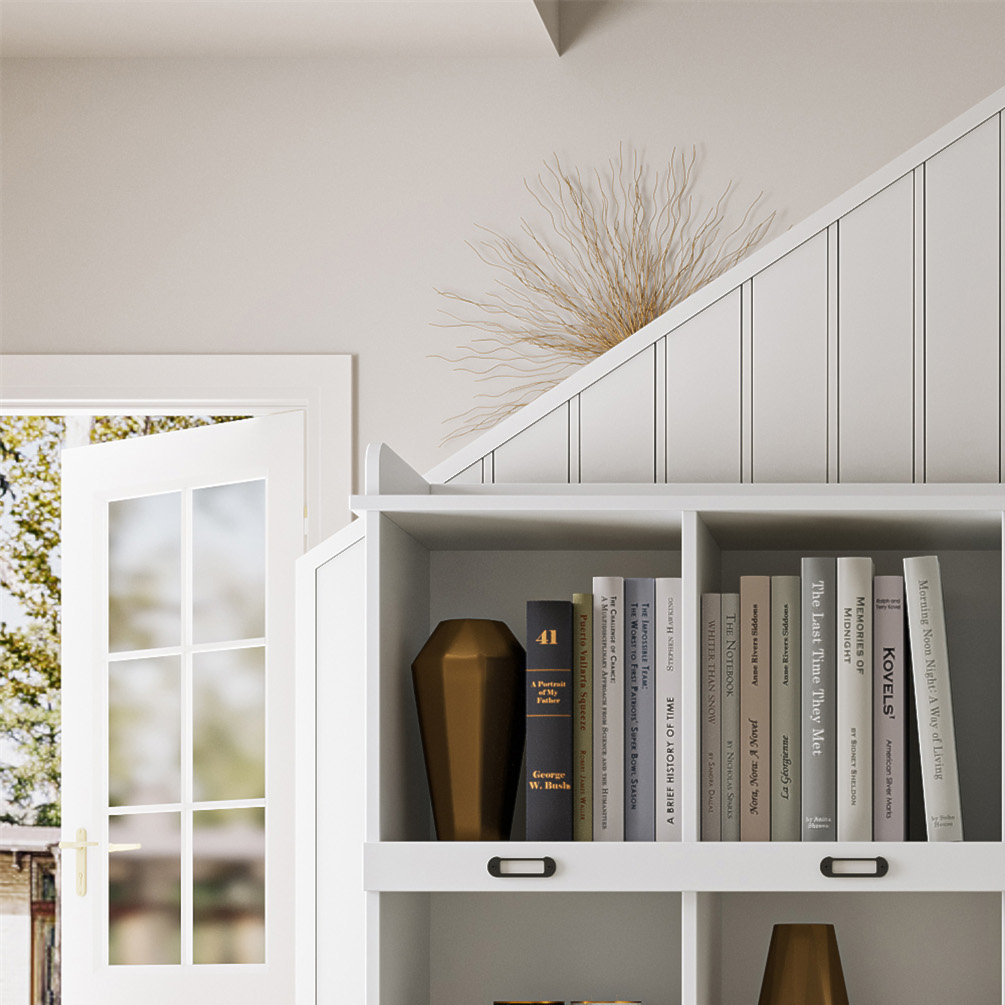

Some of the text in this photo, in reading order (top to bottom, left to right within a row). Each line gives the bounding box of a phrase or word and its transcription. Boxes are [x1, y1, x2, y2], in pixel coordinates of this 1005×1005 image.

[536, 630, 557, 644] 41
[578, 614, 589, 732] Puerto Vallarta Squeeze
[641, 603, 650, 689] THE IMPOSSIBLE TEAM:
[666, 597, 674, 671] STEPHEN HAWKING
[707, 620, 717, 725] WHITER THAN SNOW
[726, 614, 736, 698] THE NOTEBOOK
[810, 580, 825, 756] The Last Time They Met
[844, 608, 852, 663] MIDNIGHT
[856, 597, 865, 676] MEMORIES OF
[538, 689, 557, 697] of My
[630, 602, 640, 810] THE WORST TO FIRST PATRIOTS' SUPER BOWL SEASON
[919, 579, 944, 781] Morning Noon Night: A Way of Living
[666, 724, 674, 737] OF
[533, 771, 565, 780] George
